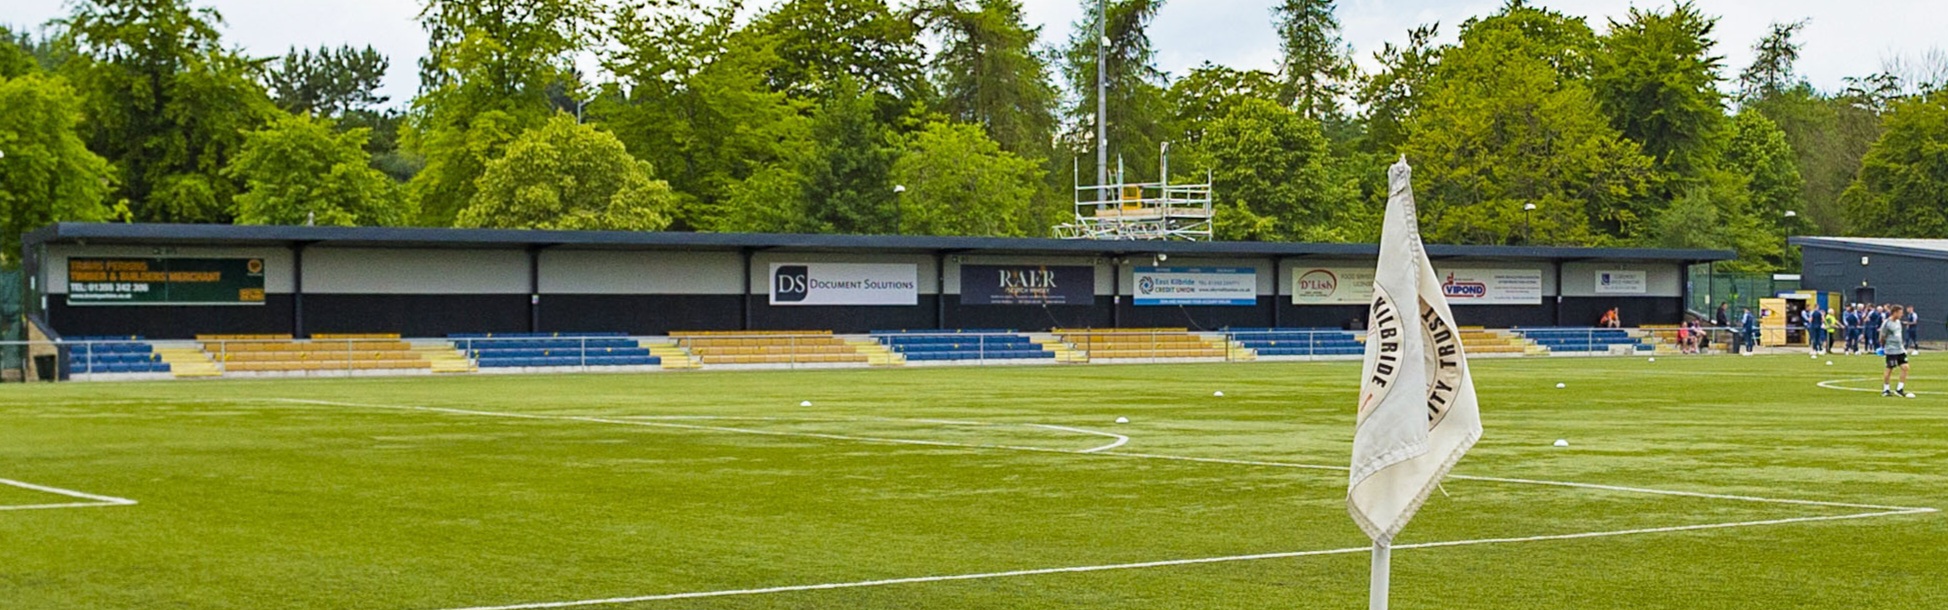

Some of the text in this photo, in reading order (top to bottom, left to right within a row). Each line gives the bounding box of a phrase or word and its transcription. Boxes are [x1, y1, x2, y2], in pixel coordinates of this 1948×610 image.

[109, 271, 117, 281] &
[120, 271, 166, 281] BUILDERS
[168, 271, 221, 282] MERCHANT
[998, 269, 1057, 288] RAER
[1155, 278, 1195, 286] East Kilbride
[778, 274, 806, 293] DS
[810, 279, 914, 289] DOCUMENT SOLUTIONS
[1301, 280, 1333, 290] D'Lish
[1446, 285, 1483, 294] VIPOND
[1372, 296, 1398, 388] KILBRIDE
[1421, 307, 1457, 369] TRUST
